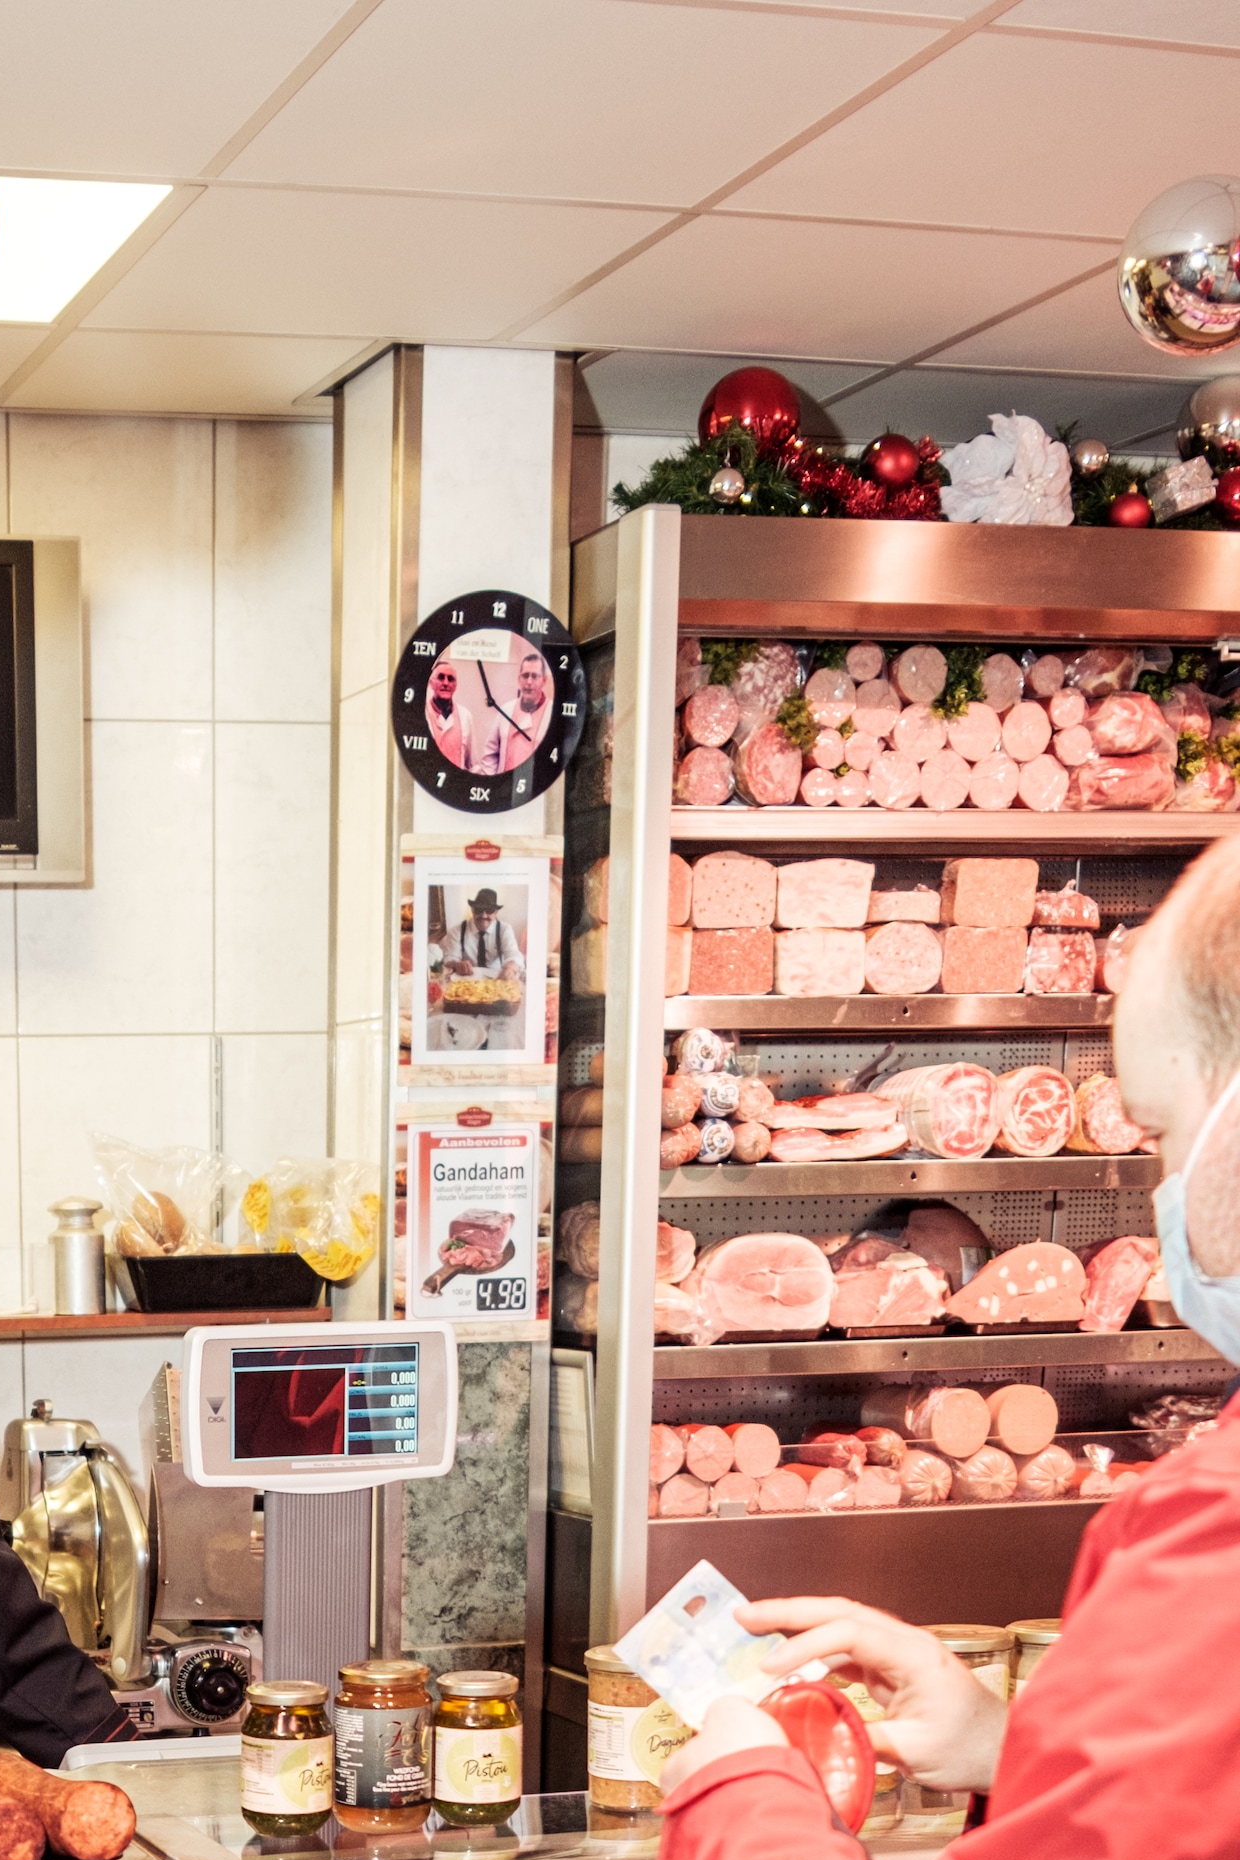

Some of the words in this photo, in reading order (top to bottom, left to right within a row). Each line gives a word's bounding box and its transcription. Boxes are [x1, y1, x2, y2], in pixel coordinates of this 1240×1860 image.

[492, 601, 507, 618] 12
[451, 610, 464, 624] 11
[527, 617, 550, 634] ONE
[413, 641, 436, 656] TEN
[559, 655, 568, 669] 2
[404, 688, 414, 703] 9
[562, 702, 578, 716] III
[403, 736, 428, 750] VIII
[550, 748, 558, 763] 4
[436, 772, 446, 787] 7
[516, 779, 526, 793] 5
[469, 787, 490, 801] SIX
[439, 1137, 521, 1148] Aanbevolen
[434, 1162, 524, 1181] Gandaham
[479, 1279, 526, 1309] 4.98
[391, 1371, 416, 1385] 0,000
[390, 1394, 416, 1408] 0,000
[395, 1417, 415, 1430] 0,00
[395, 1439, 415, 1453] 0,00
[462, 1757, 509, 1782] Pistou
